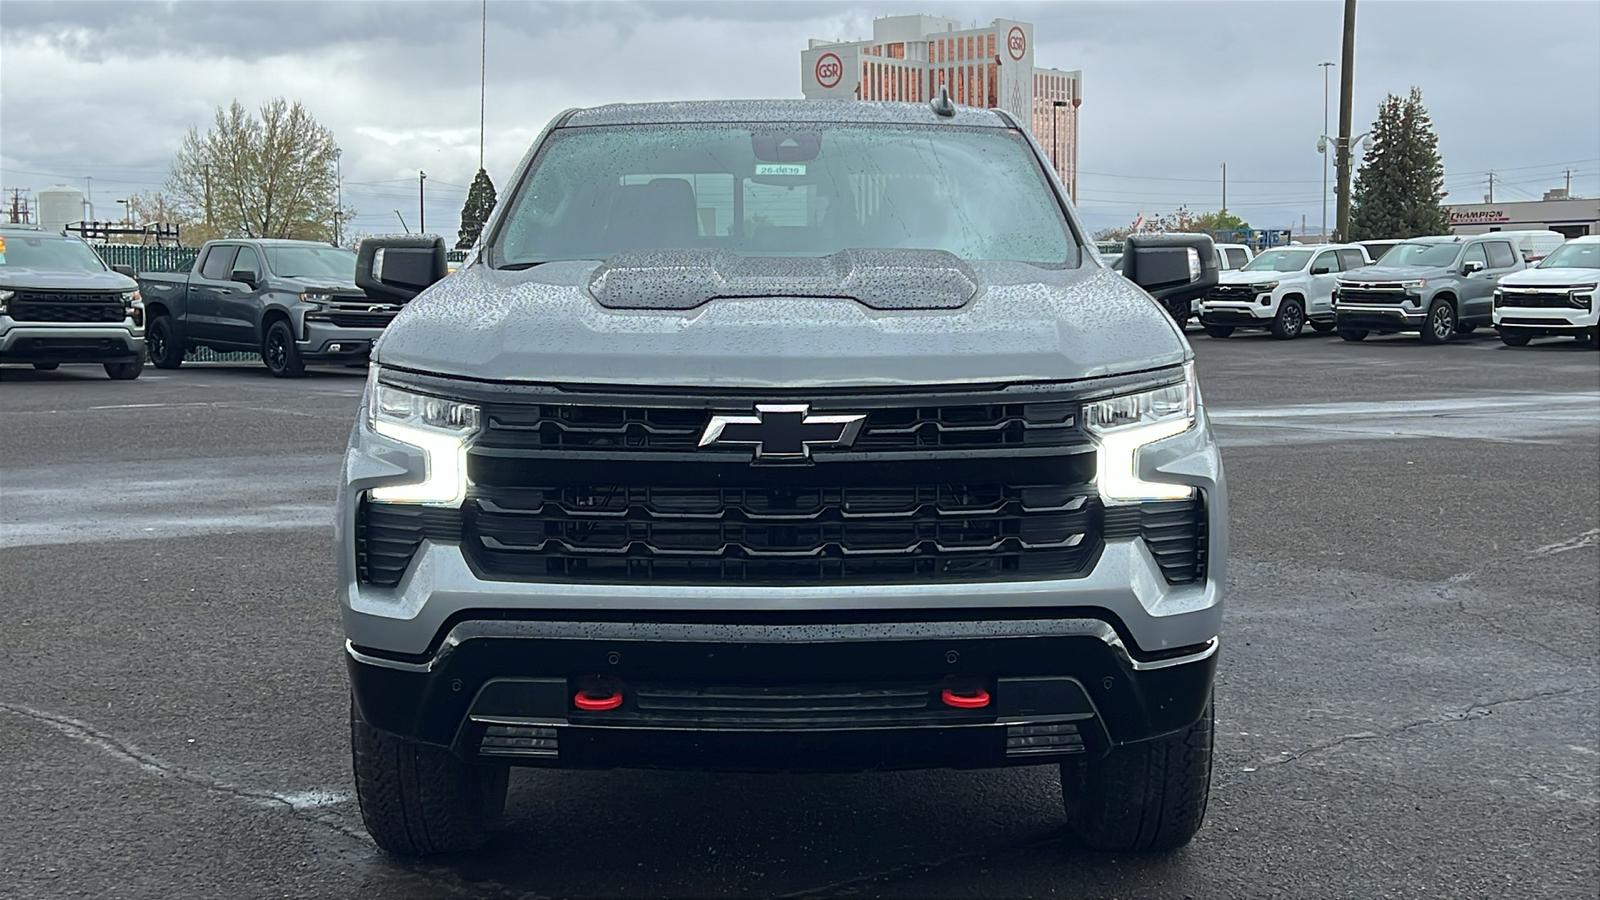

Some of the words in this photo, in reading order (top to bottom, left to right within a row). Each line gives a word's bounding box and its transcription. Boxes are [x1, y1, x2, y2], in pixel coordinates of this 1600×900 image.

[1010, 36, 1024, 51] GSR
[819, 62, 839, 78] GSR
[1450, 210, 1503, 220] CHAMPION
